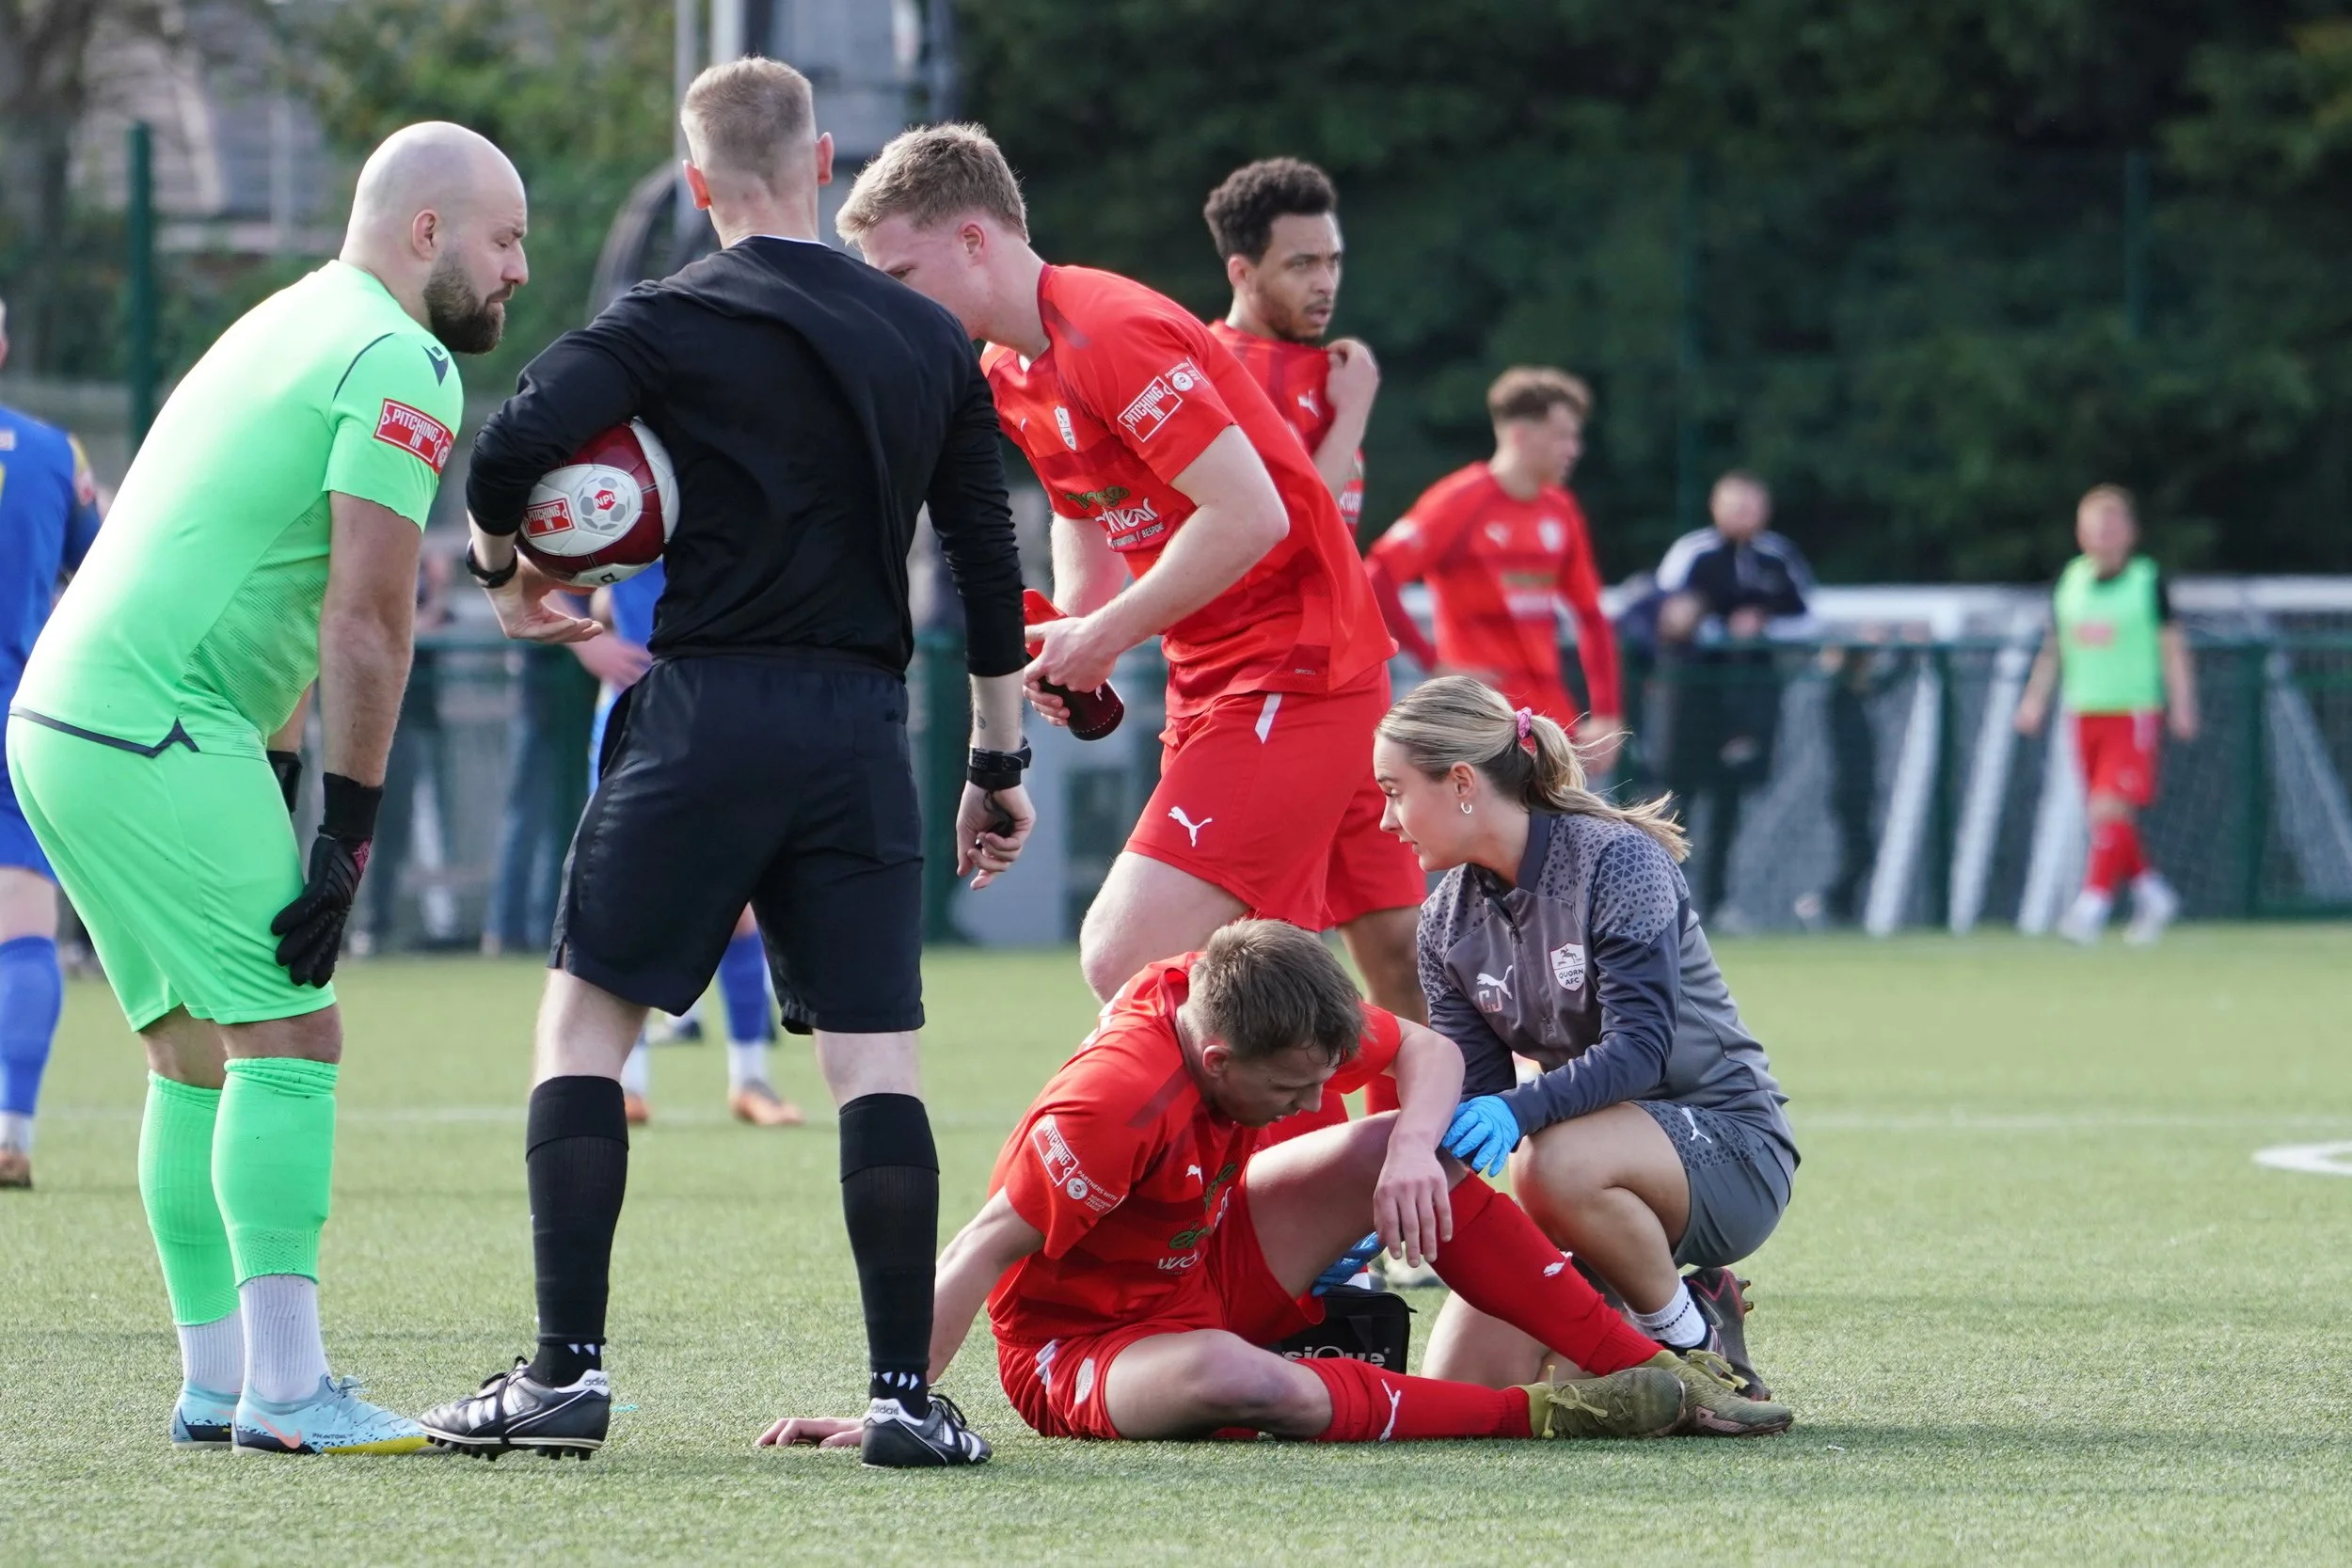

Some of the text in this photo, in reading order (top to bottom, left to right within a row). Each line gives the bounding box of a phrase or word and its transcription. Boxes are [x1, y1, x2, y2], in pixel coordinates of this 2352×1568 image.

[1124, 386, 1165, 426] PITCHING
[1148, 405, 1166, 421] IN
[392, 408, 438, 442] PITCHING
[409, 432, 423, 449] IN
[528, 505, 561, 522] PITCHING
[544, 518, 555, 531] IN
[1559, 968, 1584, 979] QUORN
[1565, 977, 1581, 986] AFC
[1077, 1170, 1104, 1195] PARTNERS
